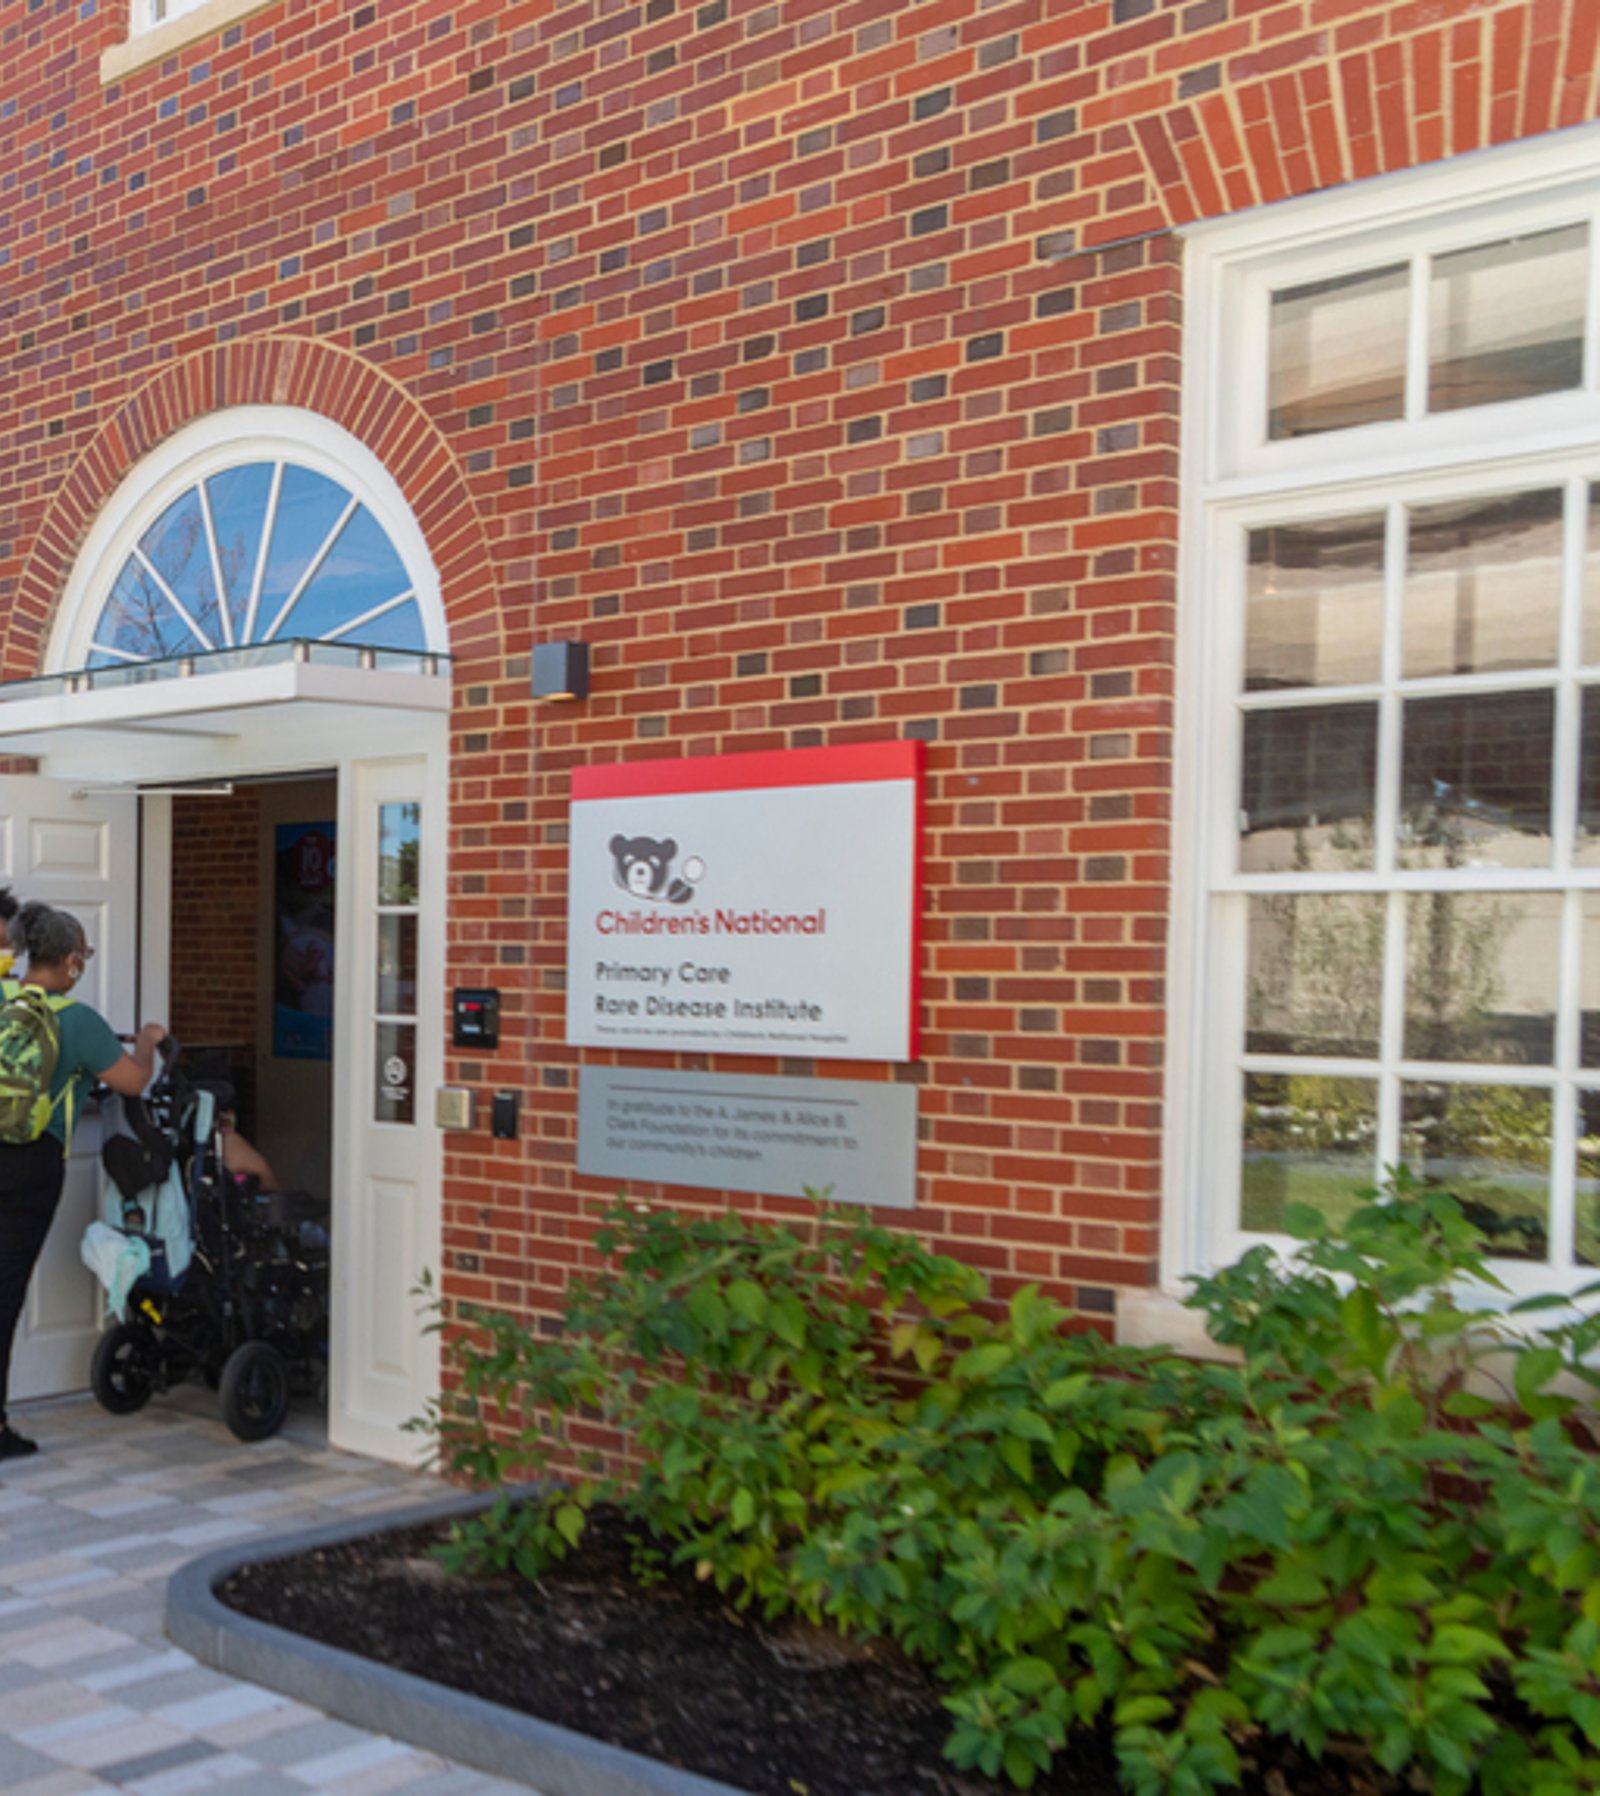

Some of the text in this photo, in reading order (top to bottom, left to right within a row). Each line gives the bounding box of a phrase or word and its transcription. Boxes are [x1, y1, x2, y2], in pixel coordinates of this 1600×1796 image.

[596, 908, 826, 935] Children's National
[595, 962, 731, 986] Primary Care
[595, 996, 823, 1021] Rare Disease Institute
[606, 1099, 620, 1112] In
[621, 1101, 676, 1116] gratitude
[678, 1105, 691, 1118] to
[693, 1105, 715, 1119] the
[716, 1106, 730, 1121] A.
[733, 1107, 777, 1123] James
[795, 1111, 831, 1129] Alice
[605, 1116, 859, 1151] Clark Foundation for its commitment to
[606, 1138, 626, 1150] our
